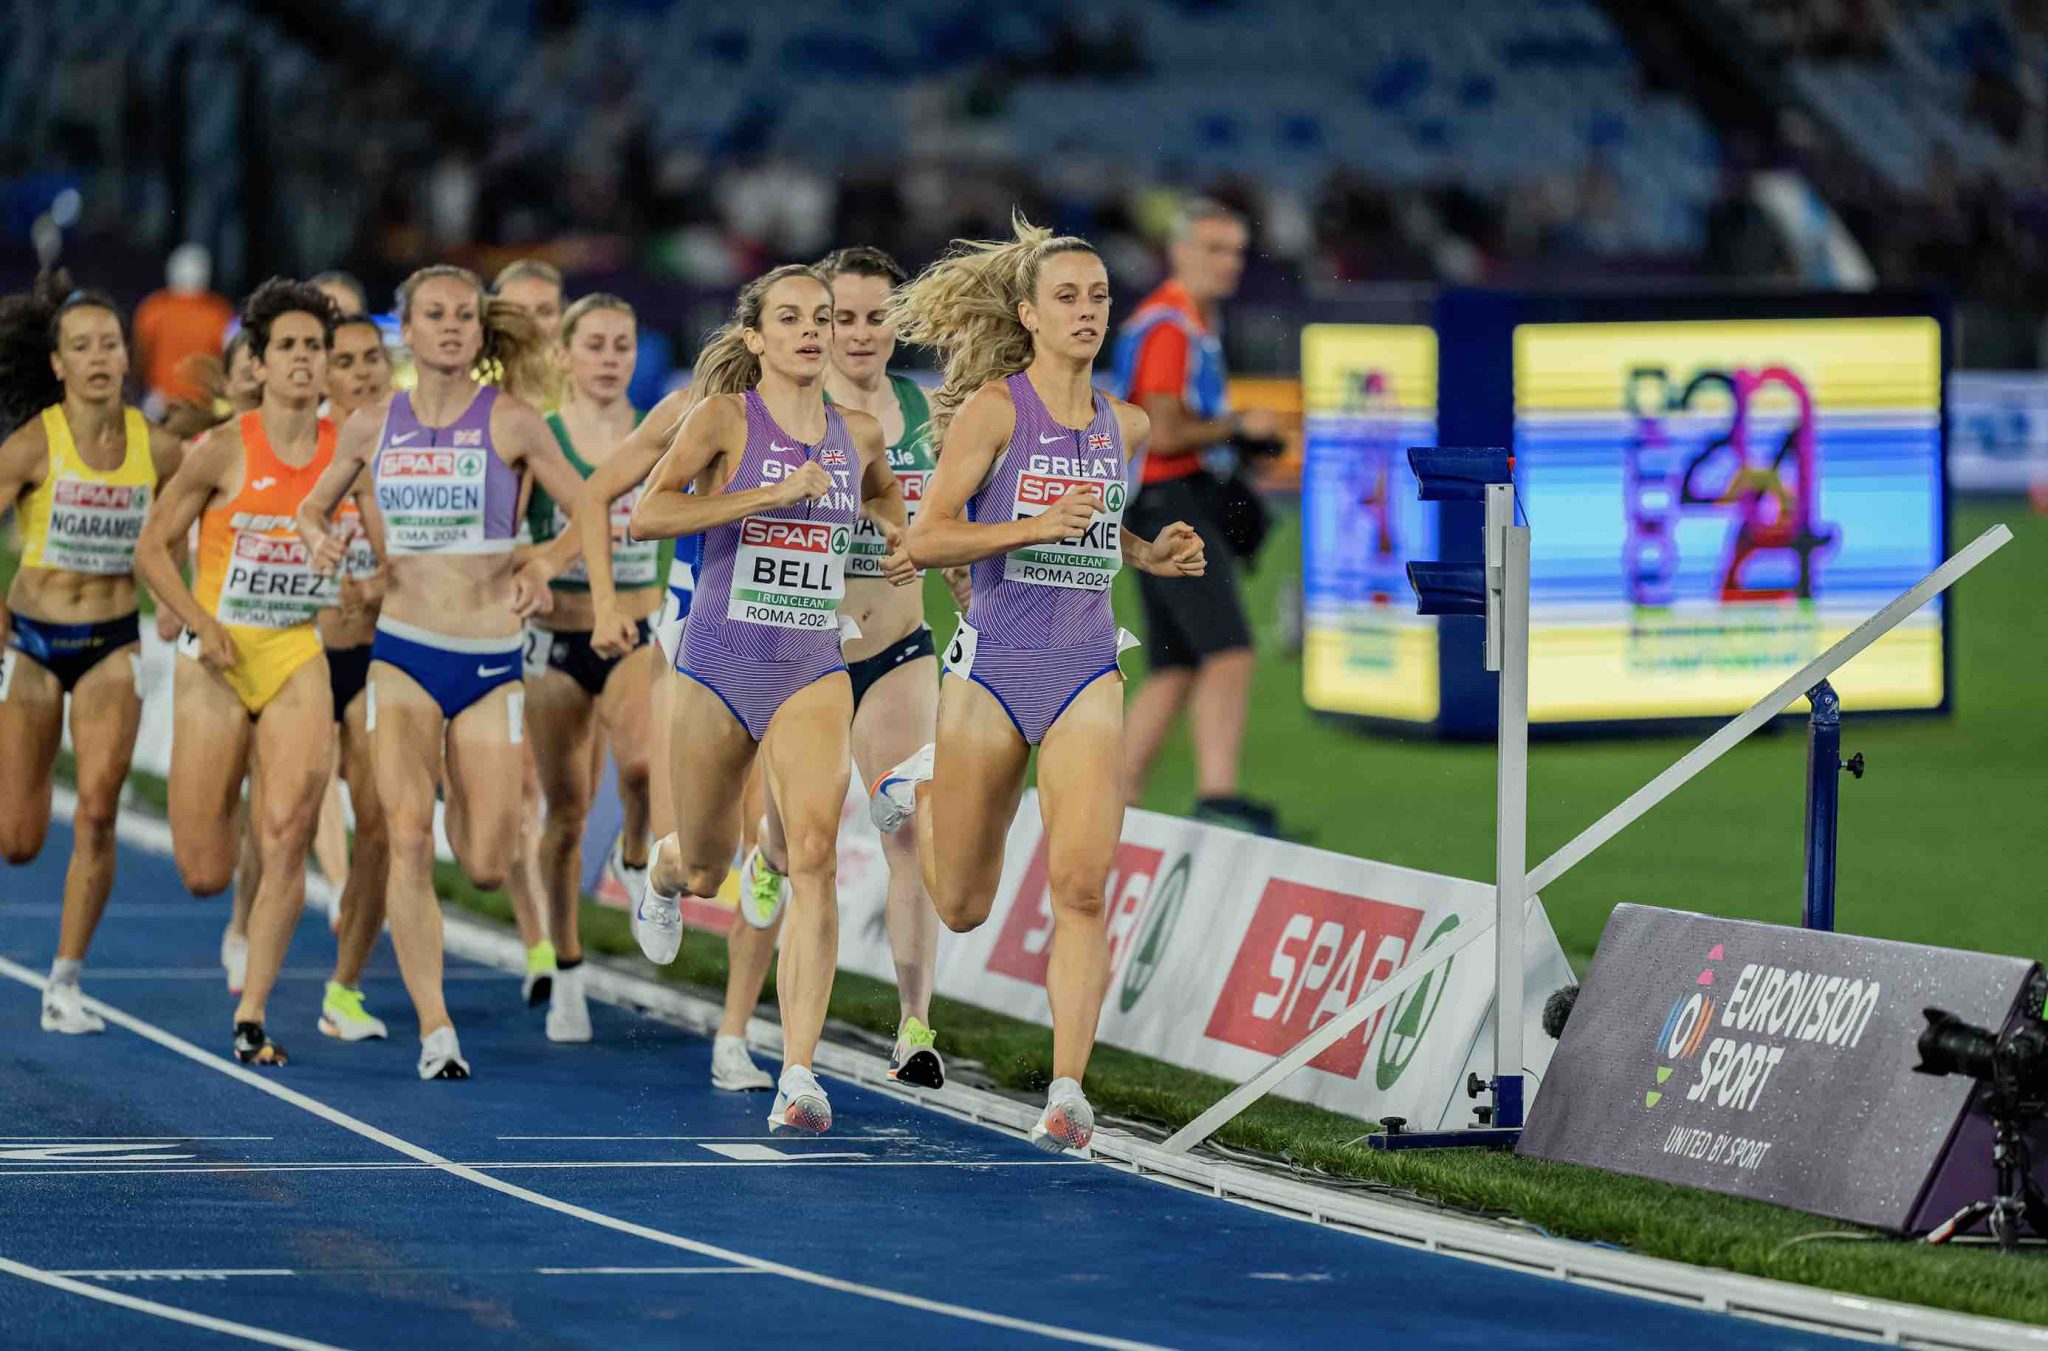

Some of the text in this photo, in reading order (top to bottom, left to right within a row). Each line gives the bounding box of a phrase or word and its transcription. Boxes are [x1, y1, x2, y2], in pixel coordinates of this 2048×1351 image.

[381, 453, 453, 475] SPAR
[886, 449, 915, 466] 3.ie
[1029, 454, 1118, 477] GREAT
[380, 485, 478, 511] SNOWDEN
[745, 522, 829, 550] SPAR
[1040, 553, 1065, 564] RUN
[230, 564, 325, 597] PÉREZ
[753, 557, 832, 591] BELL
[1023, 566, 1110, 587] ROMA 2024
[763, 593, 788, 605] RUN
[746, 605, 795, 624] ROMA
[1251, 913, 1406, 1045] SPAR
[1686, 1037, 1785, 1112] SPORT
[1663, 1126, 1772, 1170] UNITED BY SPORT
